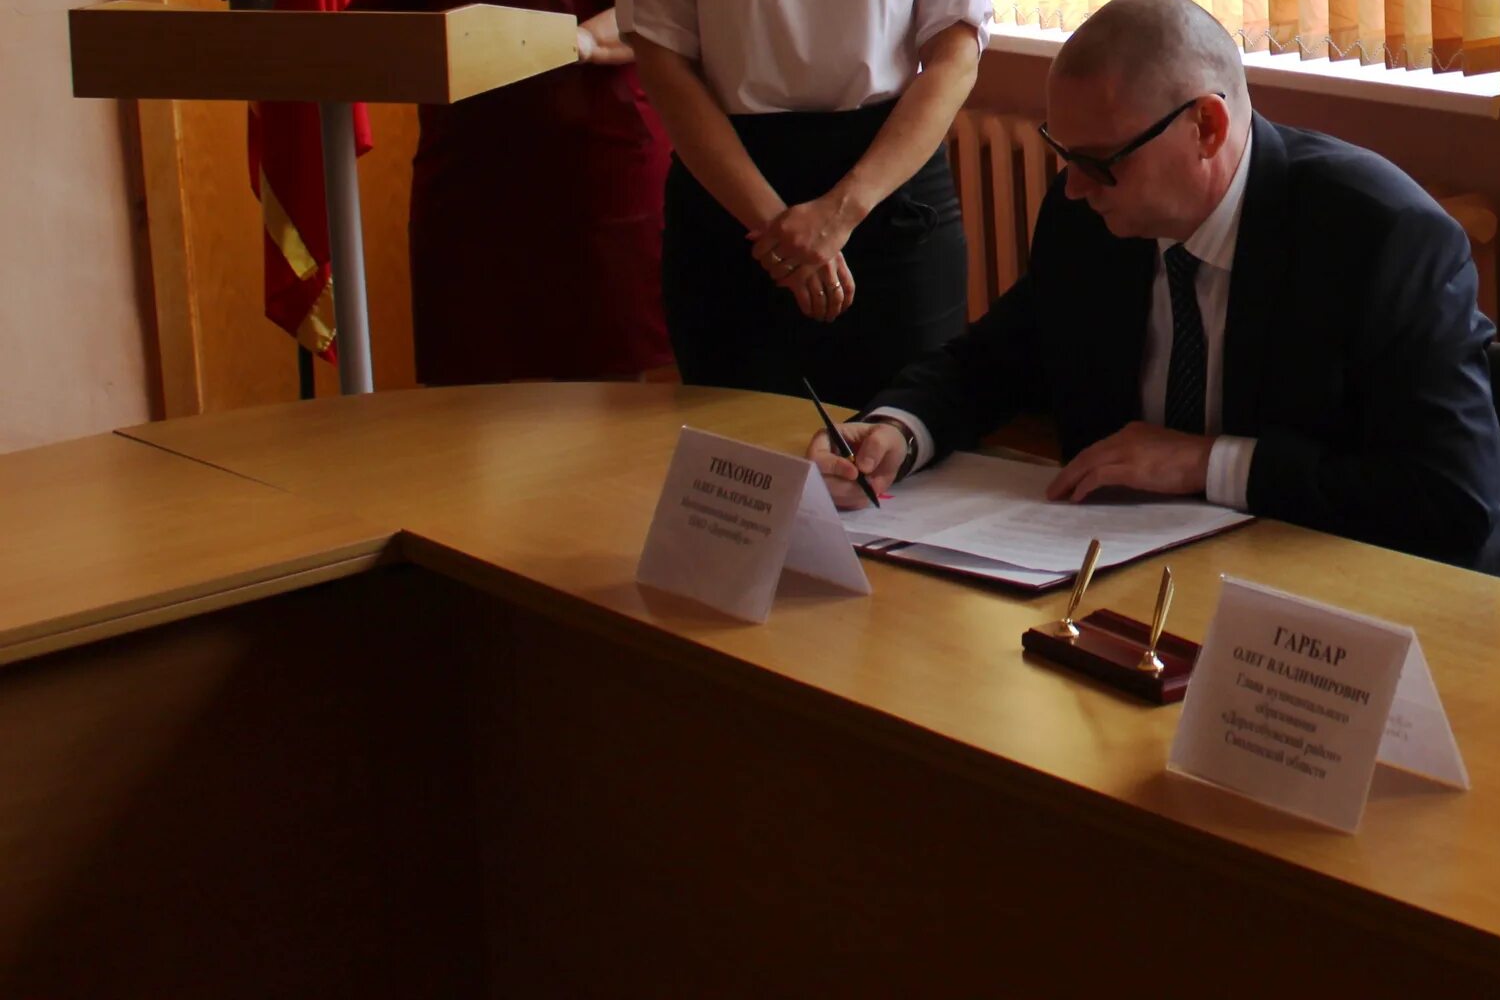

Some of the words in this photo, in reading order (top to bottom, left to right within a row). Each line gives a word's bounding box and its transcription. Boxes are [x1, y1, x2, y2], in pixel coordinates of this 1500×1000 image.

[710, 456, 772, 489] ТИХОНОВ
[1273, 626, 1346, 666] ГАРБАР
[1233, 646, 1264, 667] ОЛЕГ
[1266, 657, 1371, 706] ВЛАДИМИРОВИЧ
